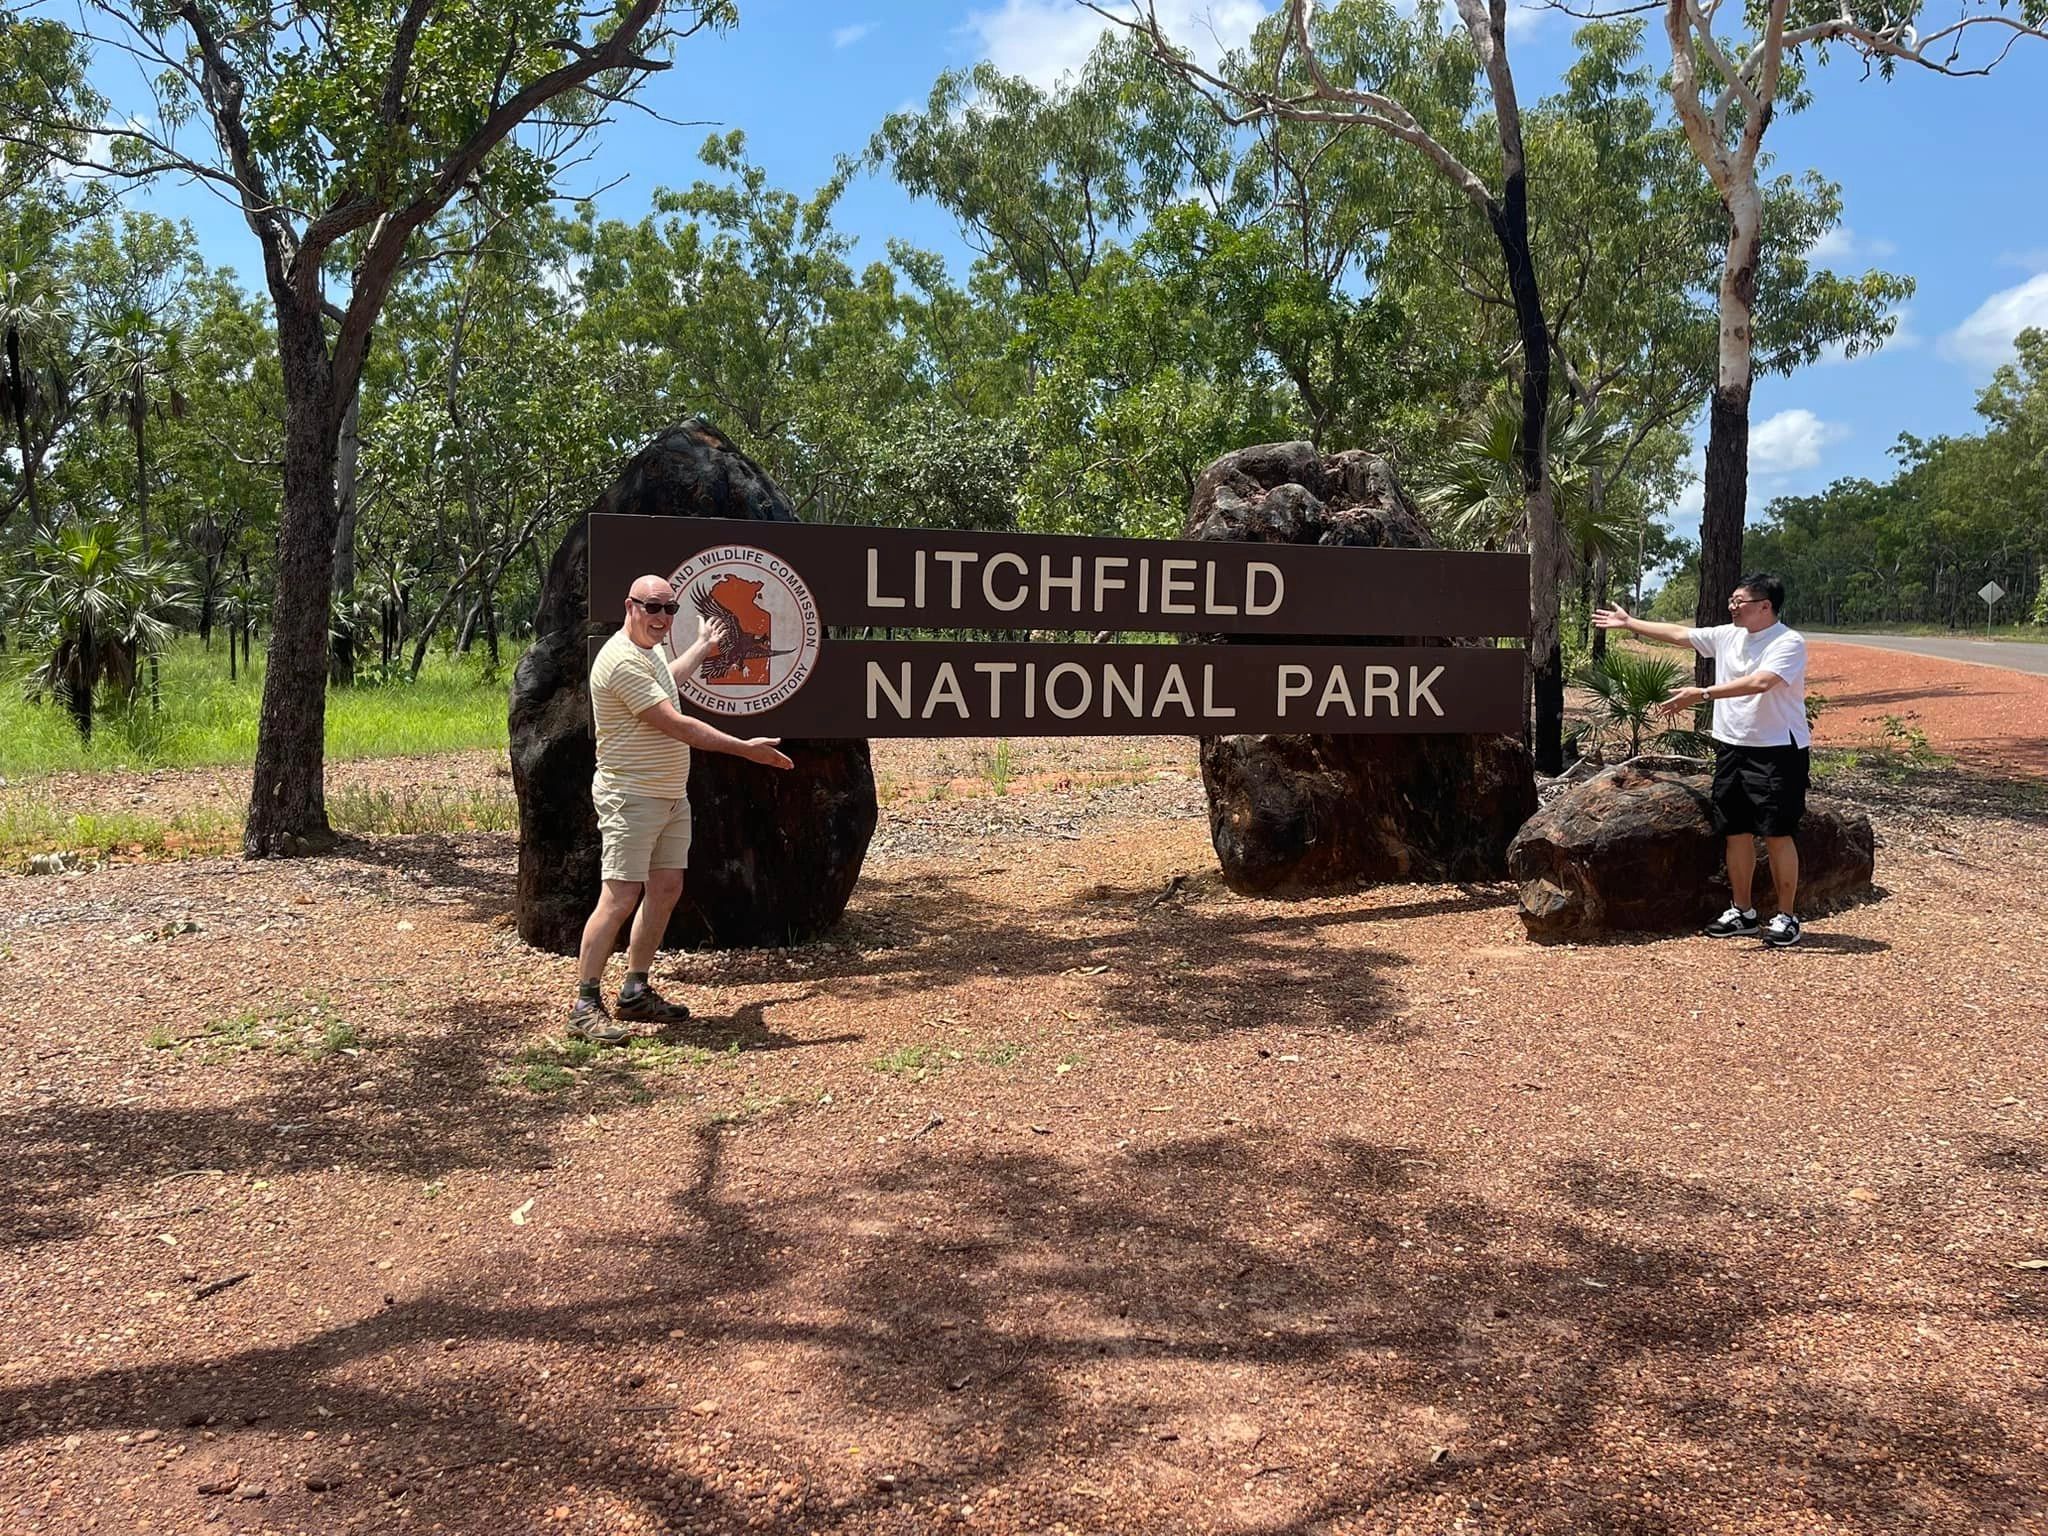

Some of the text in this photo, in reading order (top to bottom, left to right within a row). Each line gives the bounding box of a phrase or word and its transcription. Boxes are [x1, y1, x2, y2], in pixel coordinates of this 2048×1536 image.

[670, 549, 817, 649] AND WILDLIFE COMMISSION
[867, 548, 1285, 616] LITCHFIELD
[679, 662, 809, 713] RTHERN TERRITORY
[866, 661, 1445, 719] NATIONAL PARK
